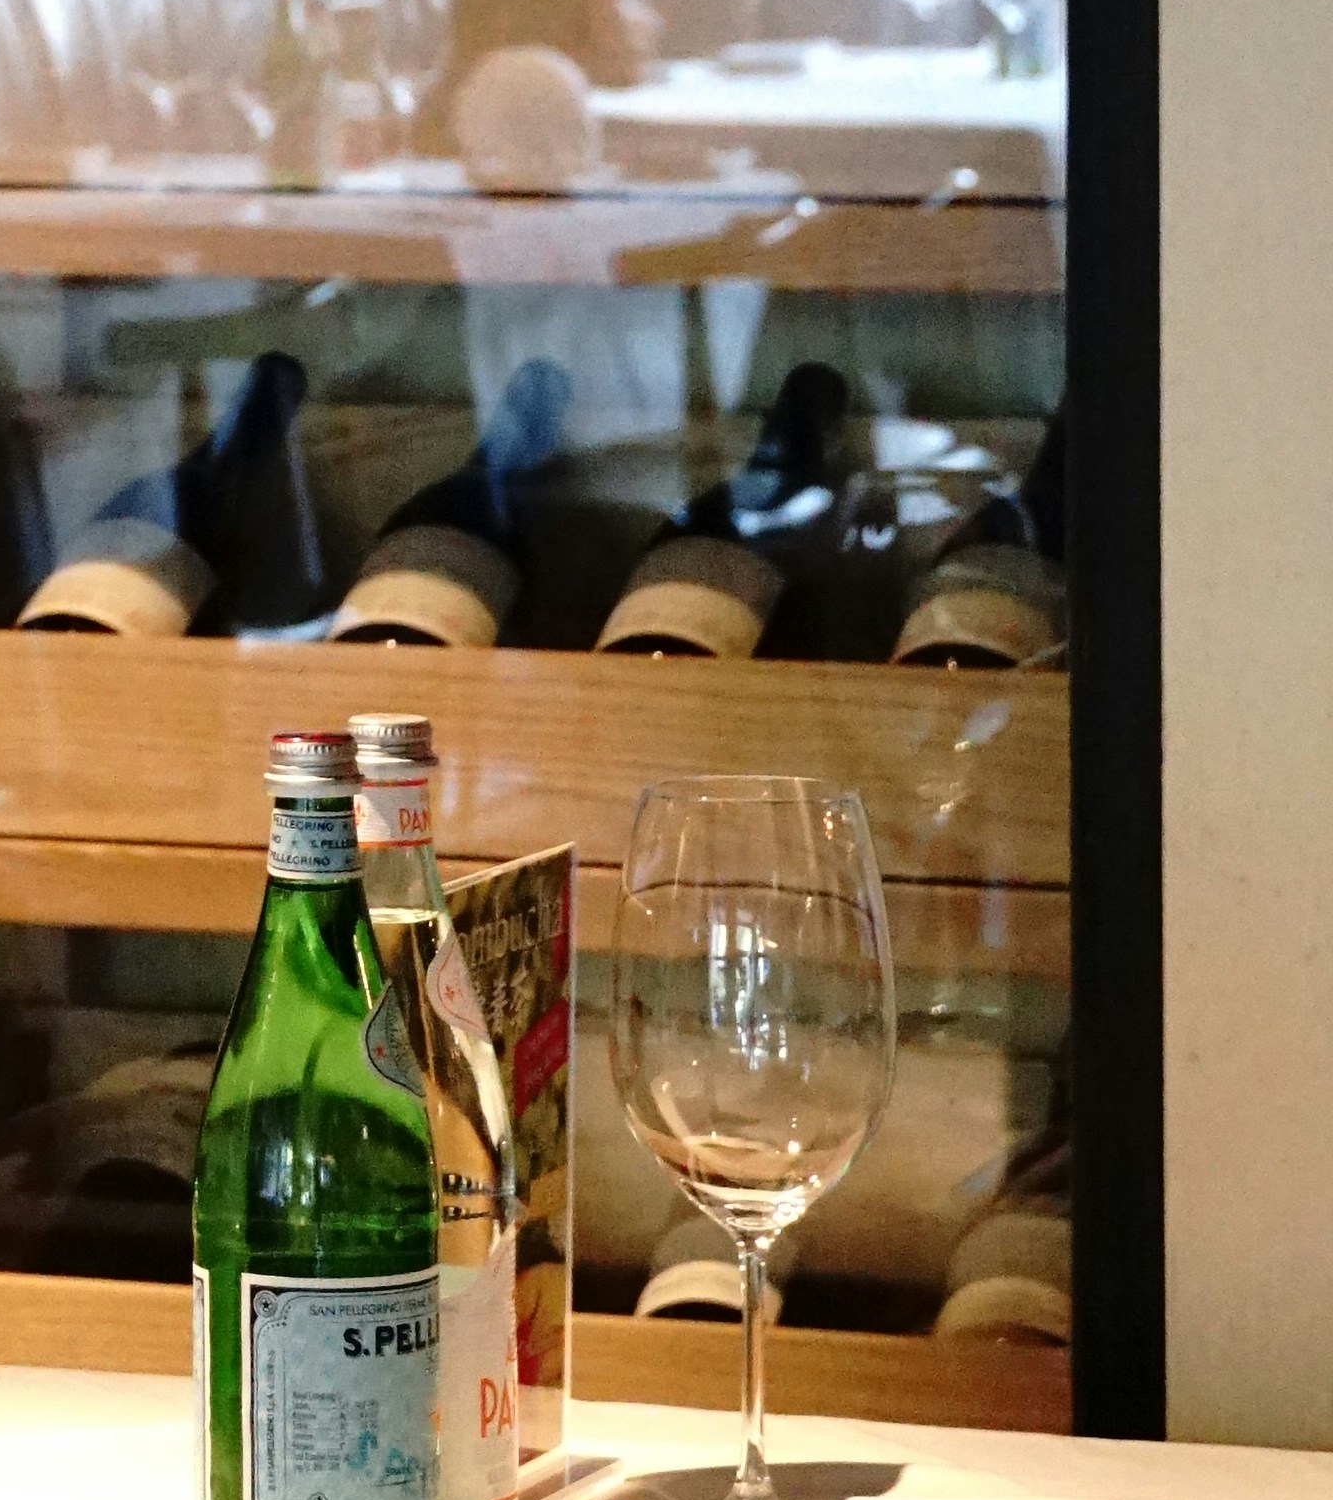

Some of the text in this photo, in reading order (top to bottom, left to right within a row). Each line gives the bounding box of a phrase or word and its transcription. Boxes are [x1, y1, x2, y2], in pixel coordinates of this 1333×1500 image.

[457, 878, 563, 967] ombucha
[343, 1312, 440, 1358] S.PELL
[480, 1376, 518, 1439] PA
